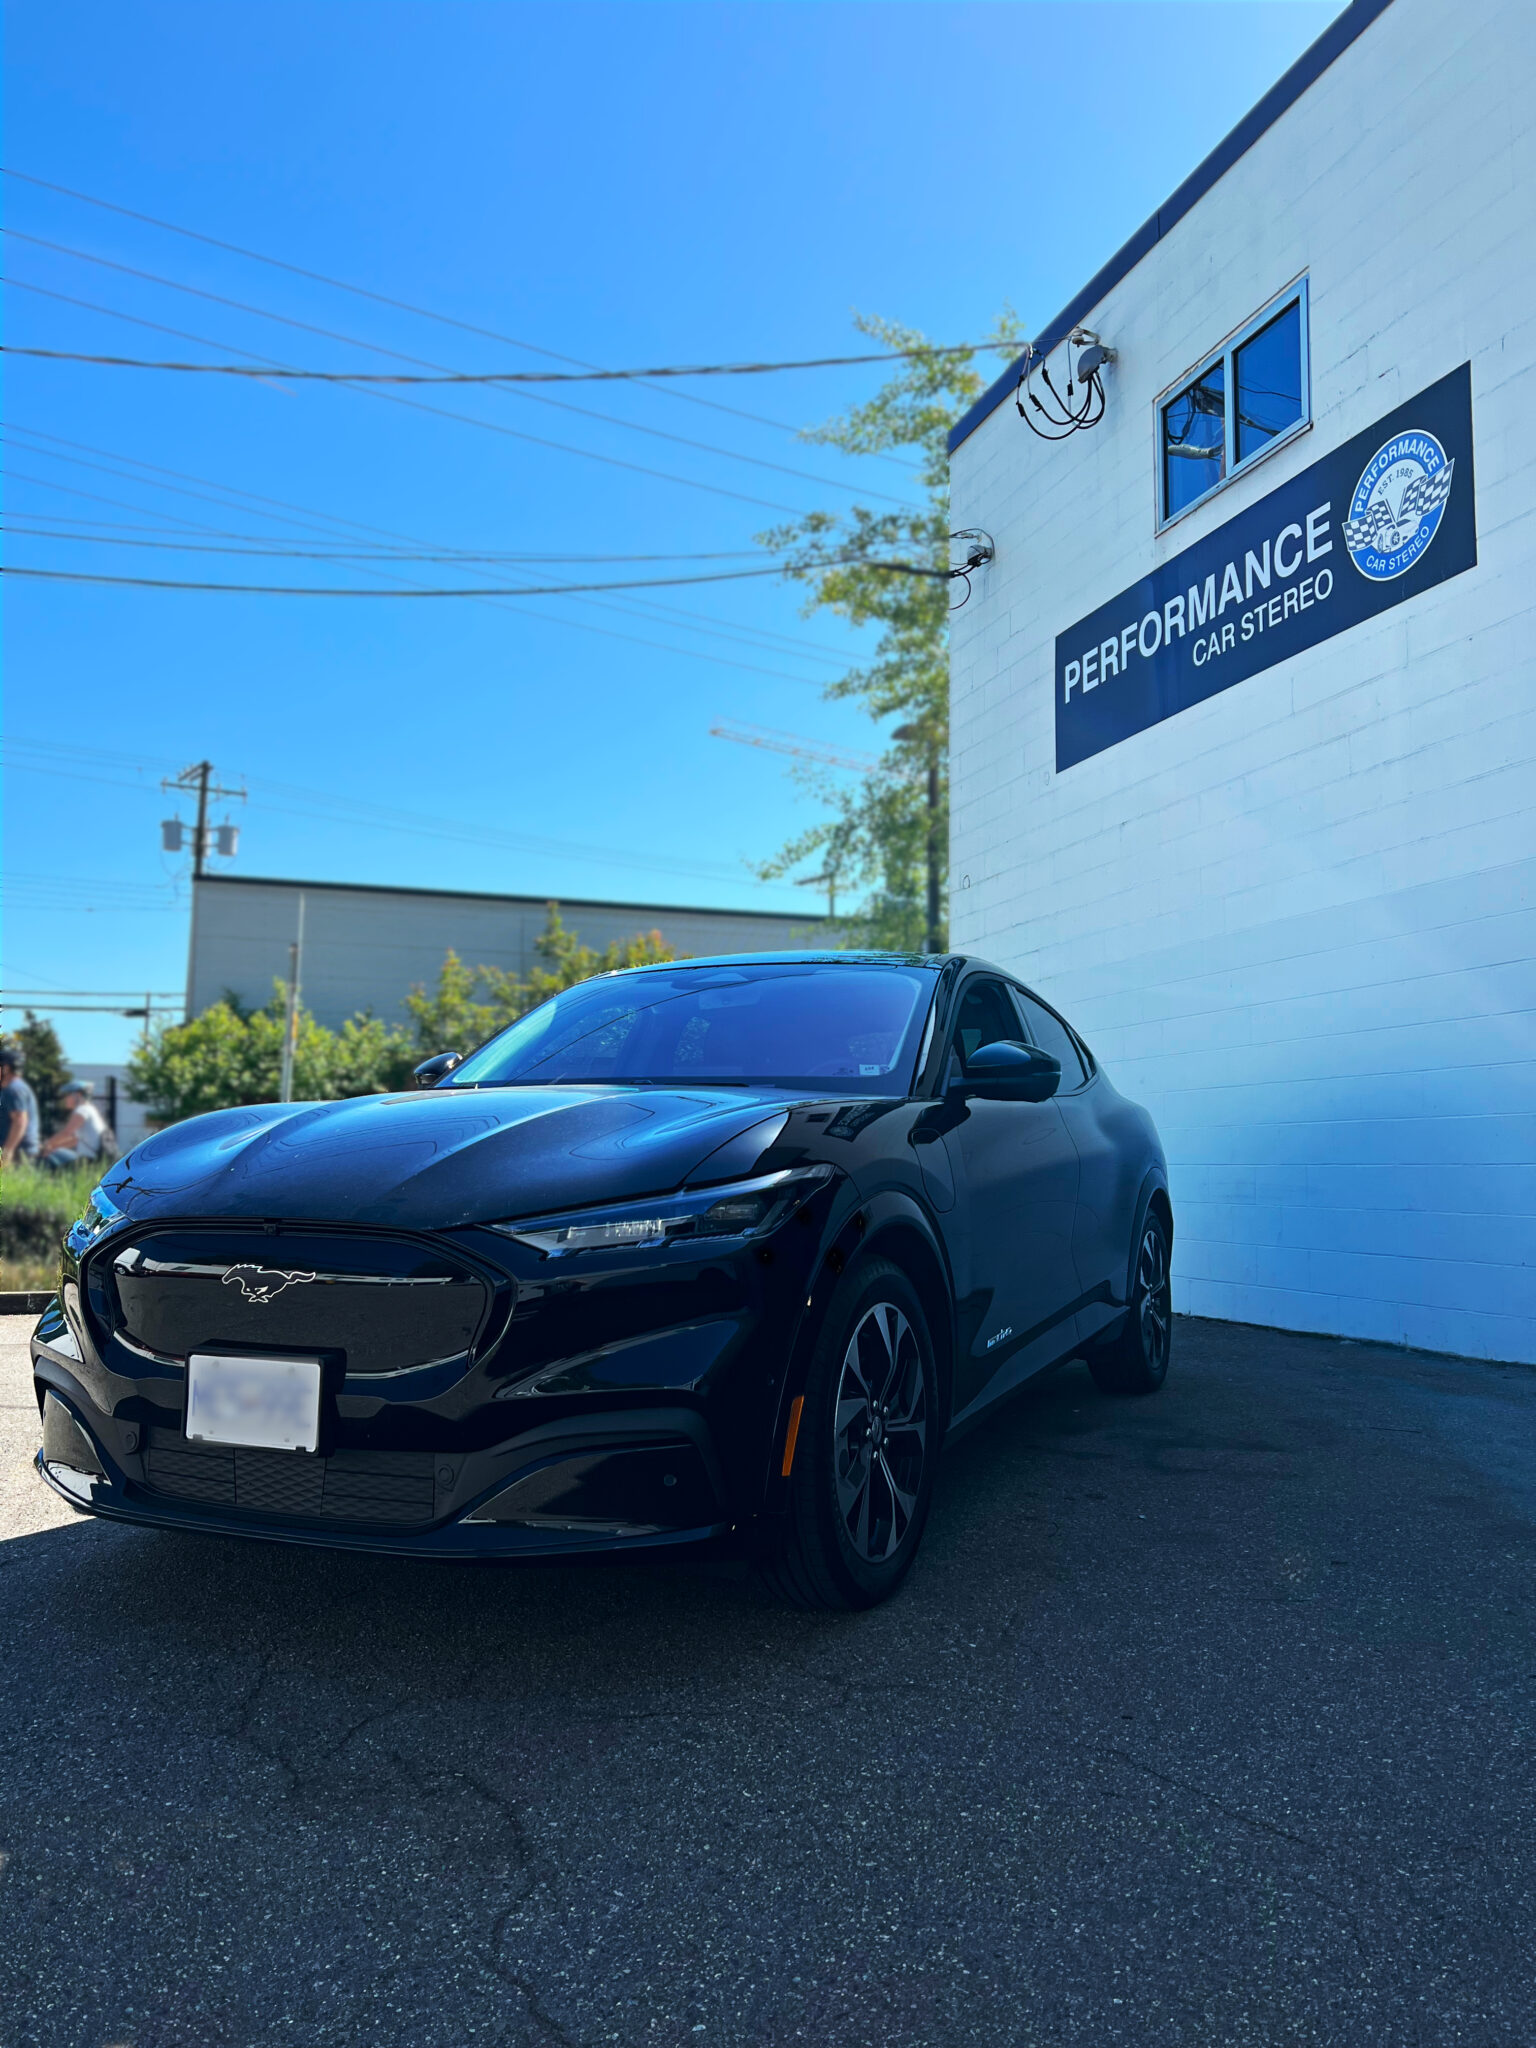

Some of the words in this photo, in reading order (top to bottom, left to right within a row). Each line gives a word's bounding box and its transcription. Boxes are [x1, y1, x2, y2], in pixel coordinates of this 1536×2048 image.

[1355, 439, 1440, 513] PERFORMANCE
[1378, 474, 1394, 495] EST.
[1396, 467, 1414, 479] 1985
[1366, 555, 1386, 571] CAR
[1388, 526, 1430, 570] STEREO
[1064, 501, 1333, 704] PERFORMANCE
[1192, 623, 1235, 668] CAR
[1241, 568, 1333, 641] STEREO
